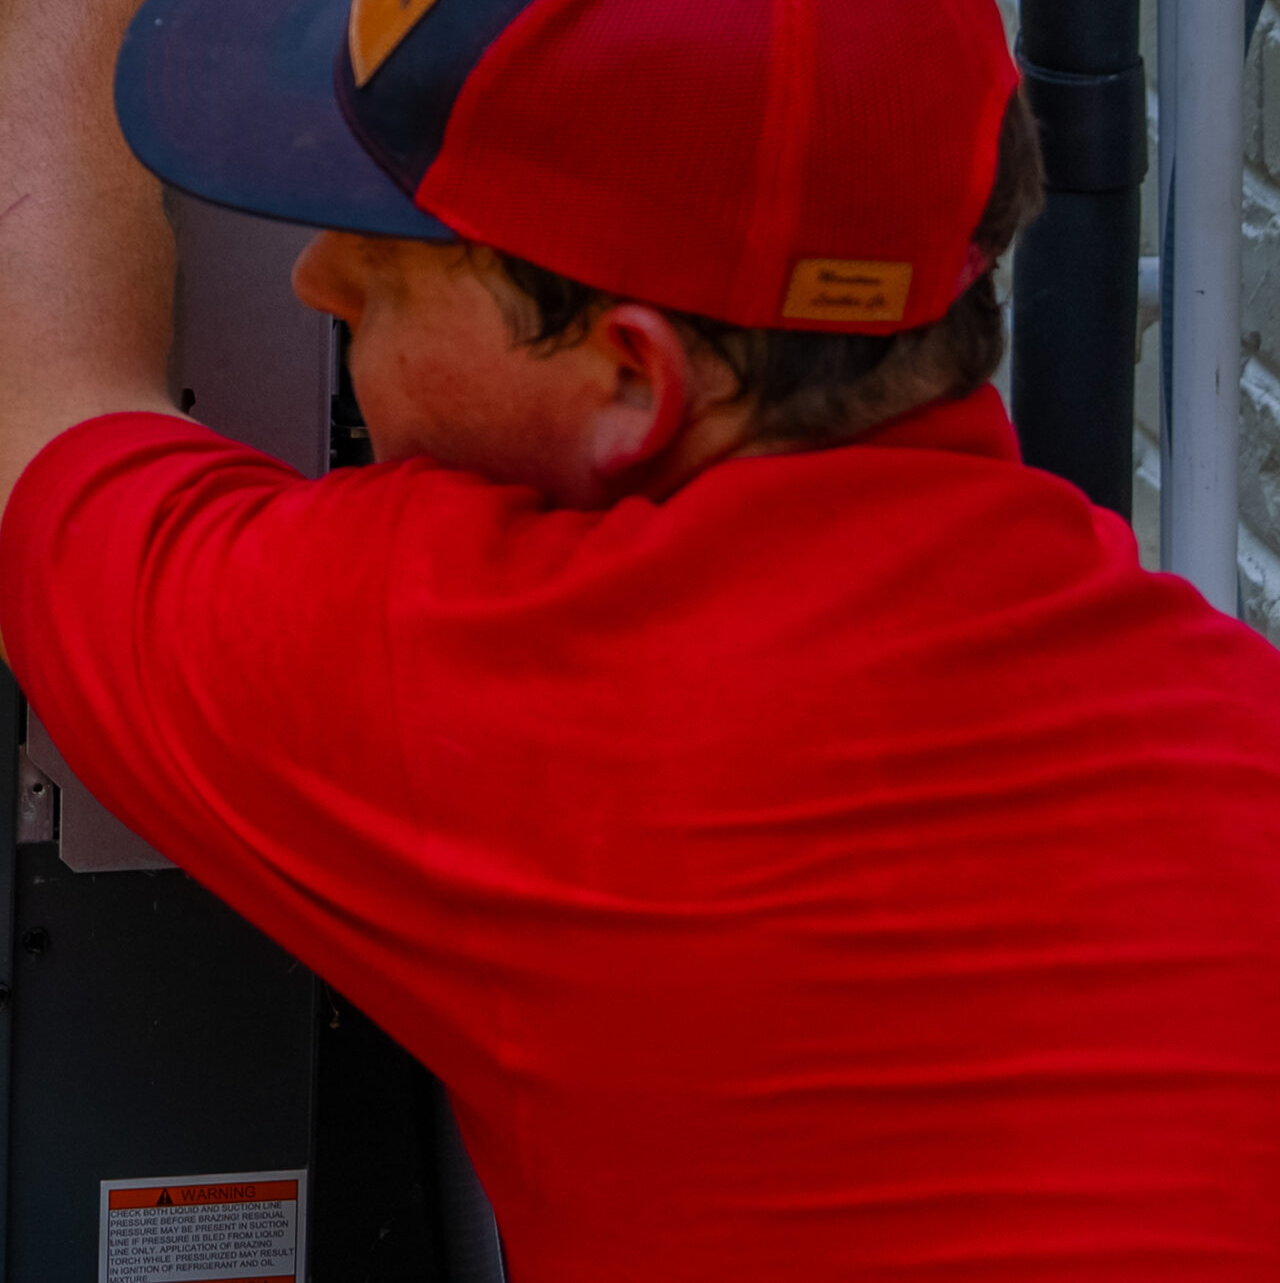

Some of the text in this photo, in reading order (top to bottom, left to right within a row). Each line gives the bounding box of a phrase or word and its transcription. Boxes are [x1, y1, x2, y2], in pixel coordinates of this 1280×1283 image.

[181, 1186, 256, 1200] WARNING
[111, 1210, 141, 1218] CHECK
[144, 1208, 167, 1216] BOTH
[170, 1207, 199, 1215] LIQUID
[222, 1203, 261, 1211] SUCTION
[263, 1201, 282, 1209] LINE
[110, 1211, 285, 1227] PRESSURE BEFORE BRAZING! RESIDUAL
[110, 1228, 158, 1236] PRESSURE
[195, 1223, 236, 1232] PRESENT
[250, 1220, 289, 1229] SUCTION
[110, 1238, 129, 1247] LINE
[142, 1236, 190, 1244] PRESSURE
[203, 1233, 225, 1241] BLED
[256, 1230, 284, 1238] LIQUID
[110, 1248, 128, 1256] LINE
[132, 1247, 157, 1255] ONLY.
[160, 1242, 217, 1253] APPLICATION
[234, 1240, 272, 1249] BRAZING
[111, 1257, 140, 1266] TORCH
[143, 1255, 171, 1263] WHILE
[176, 1251, 237, 1261] PRESSURIZED
[260, 1248, 294, 1256] RESULT
[121, 1265, 159, 1274] IGNITION
[176, 1261, 238, 1270] REFRIGERANT
[261, 1258, 274, 1266] OIL
